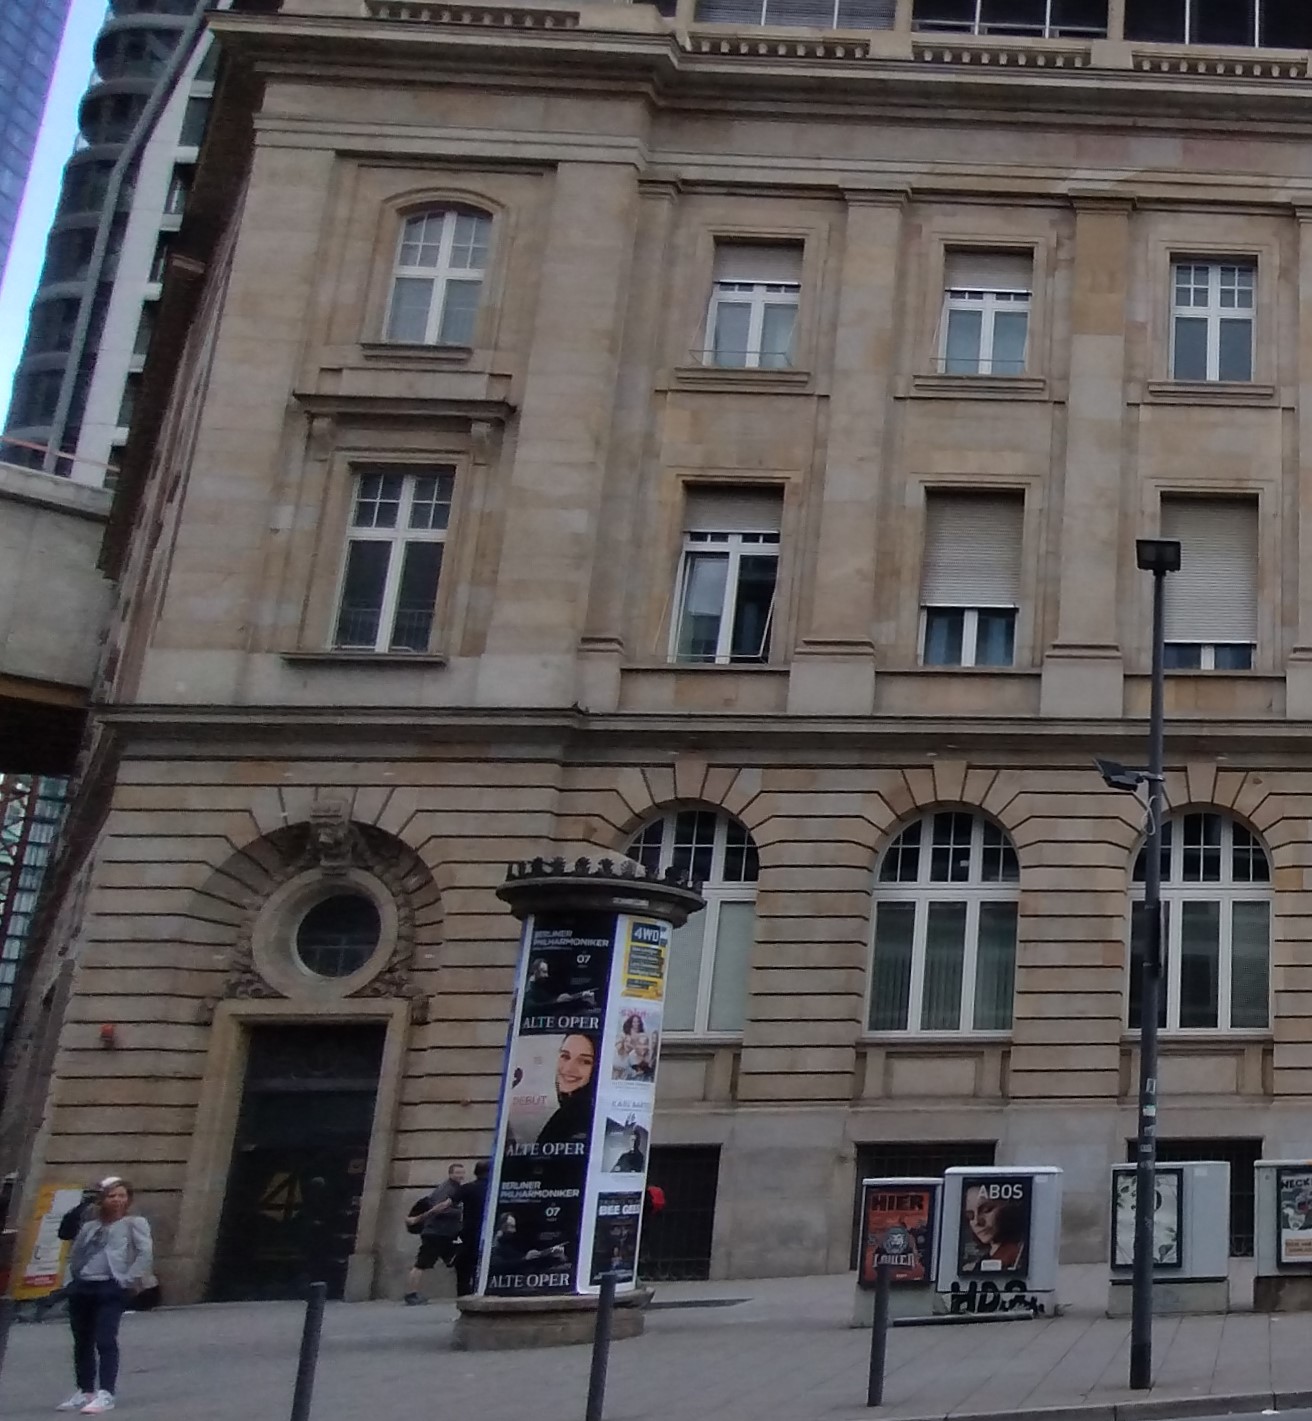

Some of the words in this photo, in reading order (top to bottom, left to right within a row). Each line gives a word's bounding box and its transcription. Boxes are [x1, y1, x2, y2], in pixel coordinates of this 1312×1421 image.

[633, 926, 660, 942] 4WD
[576, 954, 591, 964] 07
[522, 1016, 555, 1029] ALTE
[557, 1015, 599, 1030] OPER
[505, 1143, 540, 1156] ALTE
[542, 1142, 585, 1156] OPER
[501, 1181, 542, 1190] BERLINER
[977, 1184, 1024, 1199] ABOS
[500, 1189, 580, 1198] PHILHARMONIKER
[871, 1194, 925, 1212] HIER
[545, 1207, 561, 1217] 07
[488, 1274, 524, 1288] ALTE
[526, 1273, 570, 1287] OPER
